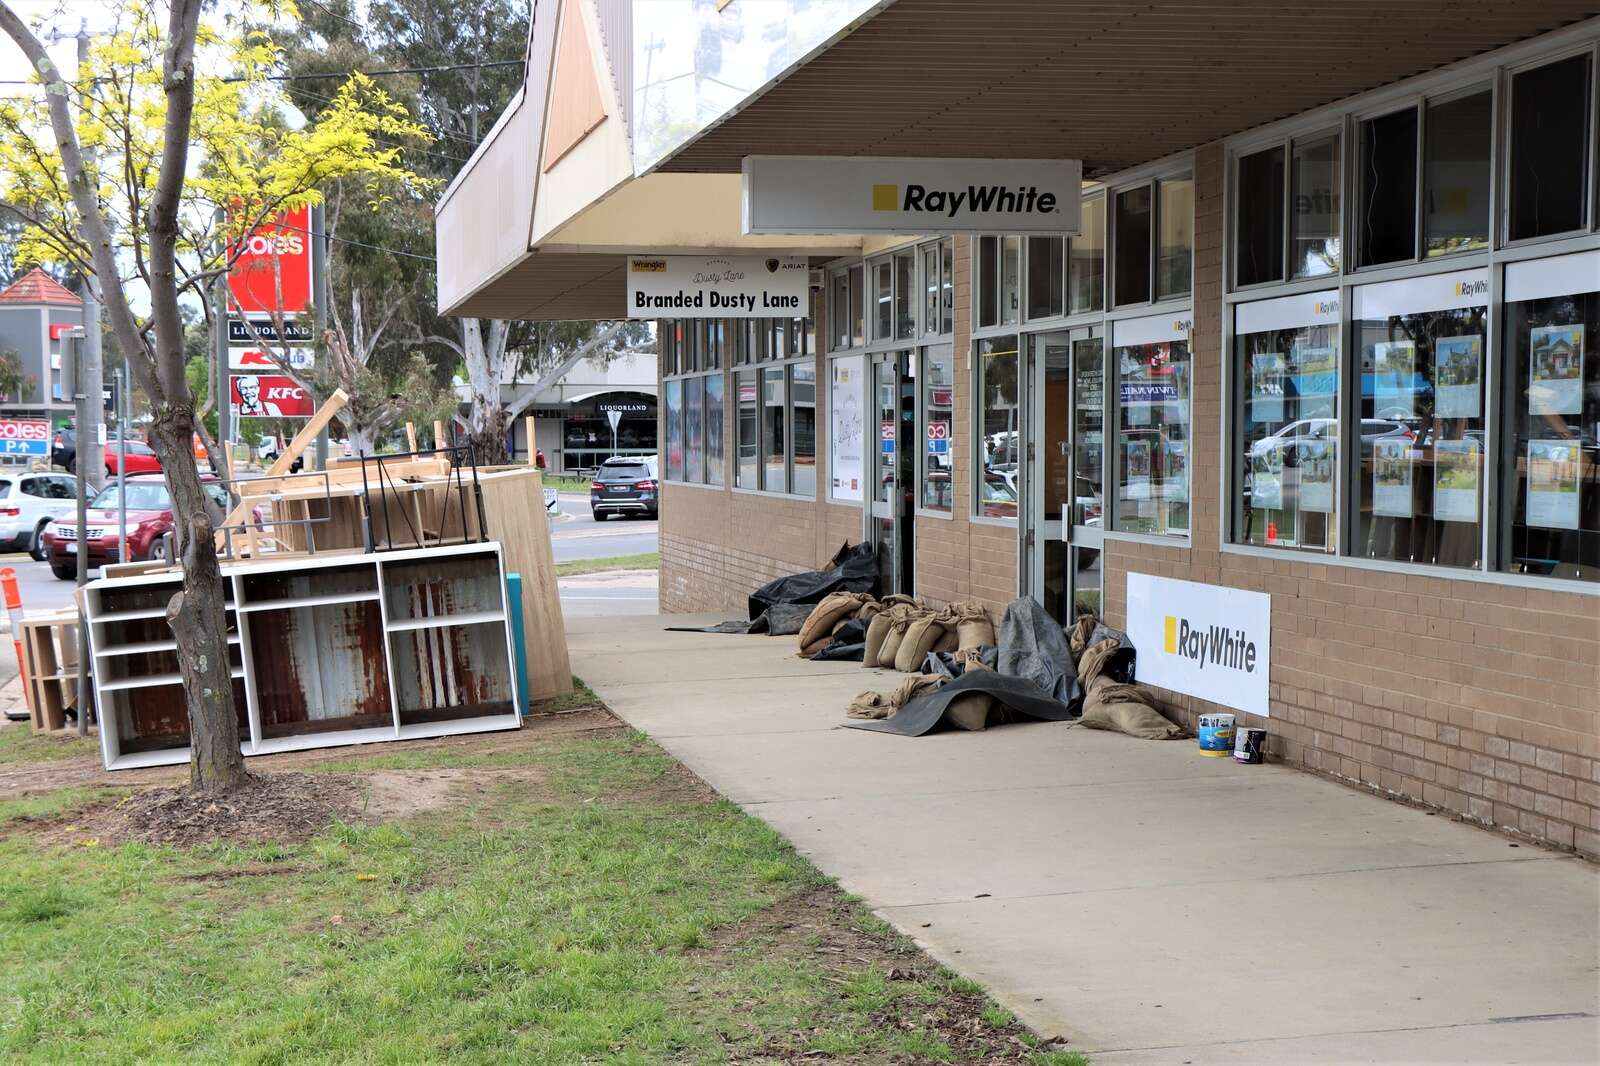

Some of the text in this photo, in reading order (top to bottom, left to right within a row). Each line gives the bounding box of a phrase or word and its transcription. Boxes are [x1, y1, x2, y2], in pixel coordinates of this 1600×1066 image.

[903, 184, 1056, 217] RayWhite
[238, 235, 304, 254] oles
[633, 260, 666, 271] Wrangler
[635, 290, 799, 311] Branded Dusty Lane
[233, 326, 309, 335] LIUORAND
[267, 387, 303, 399] KFC
[6, 440, 17, 452] P
[1178, 618, 1257, 673] RayWhite
